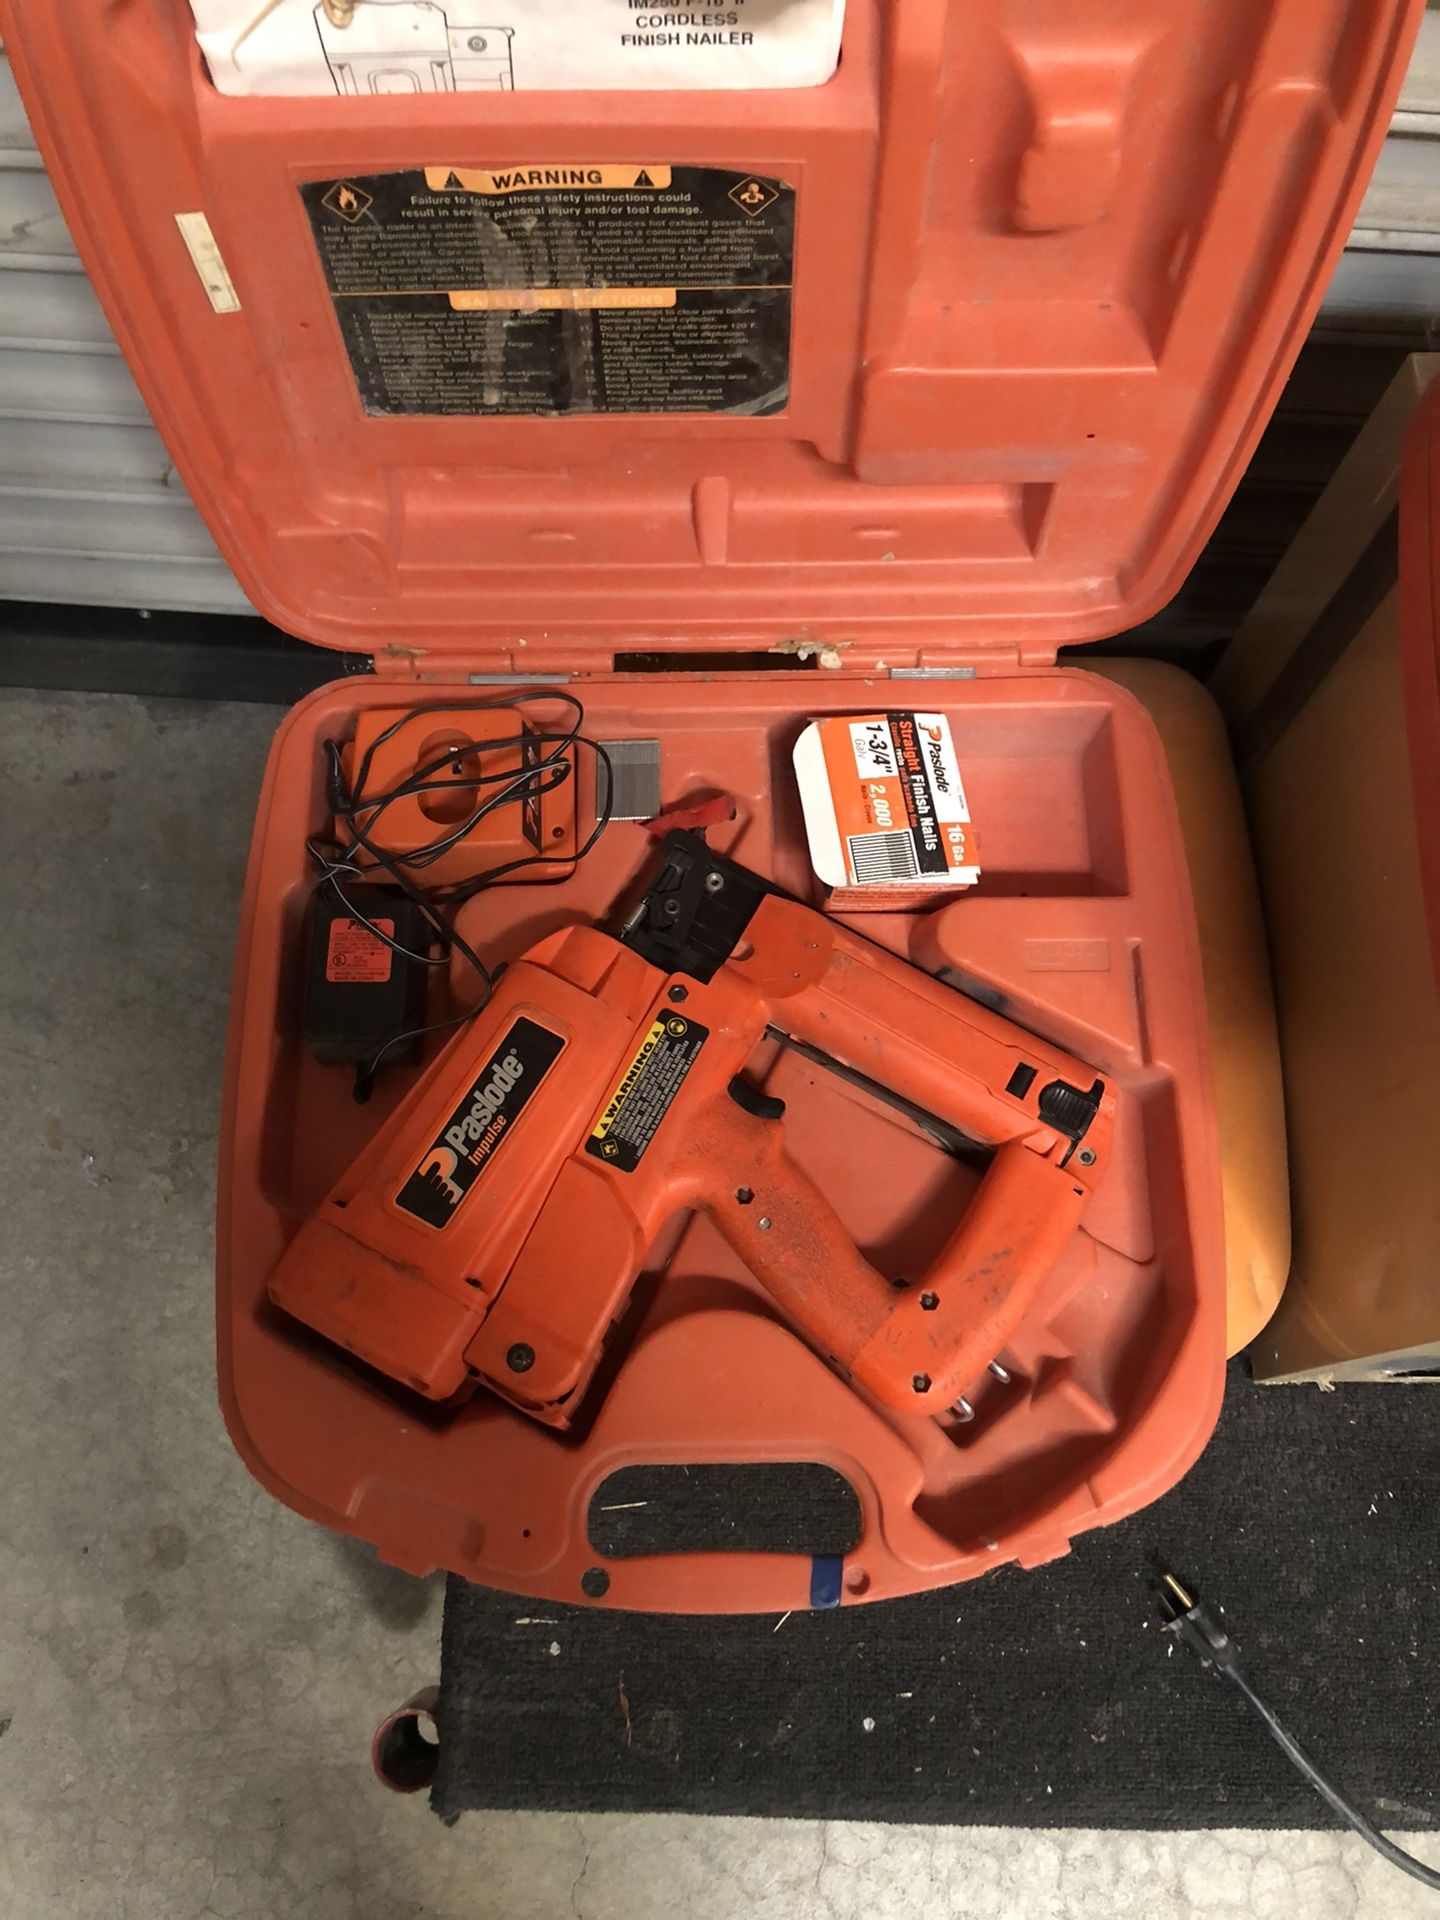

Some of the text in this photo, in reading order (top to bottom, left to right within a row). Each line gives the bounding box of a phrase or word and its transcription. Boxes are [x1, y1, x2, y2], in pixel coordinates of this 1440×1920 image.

[635, 11, 738, 28] CORDLESS
[621, 31, 754, 46] FINISH NAILER
[492, 169, 603, 189] WARNING
[411, 192, 692, 207] Failure to follow these safety instructions could
[401, 205, 703, 220] result in severe personal injury and/or tool damage.
[598, 220, 646, 229] produces
[649, 219, 666, 227] hot
[669, 219, 708, 227] exhaust
[712, 220, 742, 229] gases
[646, 228, 708, 236] combustible
[854, 738, 866, 760] Galv
[865, 724, 893, 773] 1-3/4"
[896, 748, 905, 766] recto
[927, 741, 950, 793] Paslode
[899, 721, 938, 851] Straight Finish Nails
[869, 784, 893, 827] 2,000
[946, 825, 966, 866] 16 Ga.
[605, 1041, 655, 1119] WARNING
[444, 1053, 524, 1157] Paslode
[467, 1114, 507, 1167] Impulse
